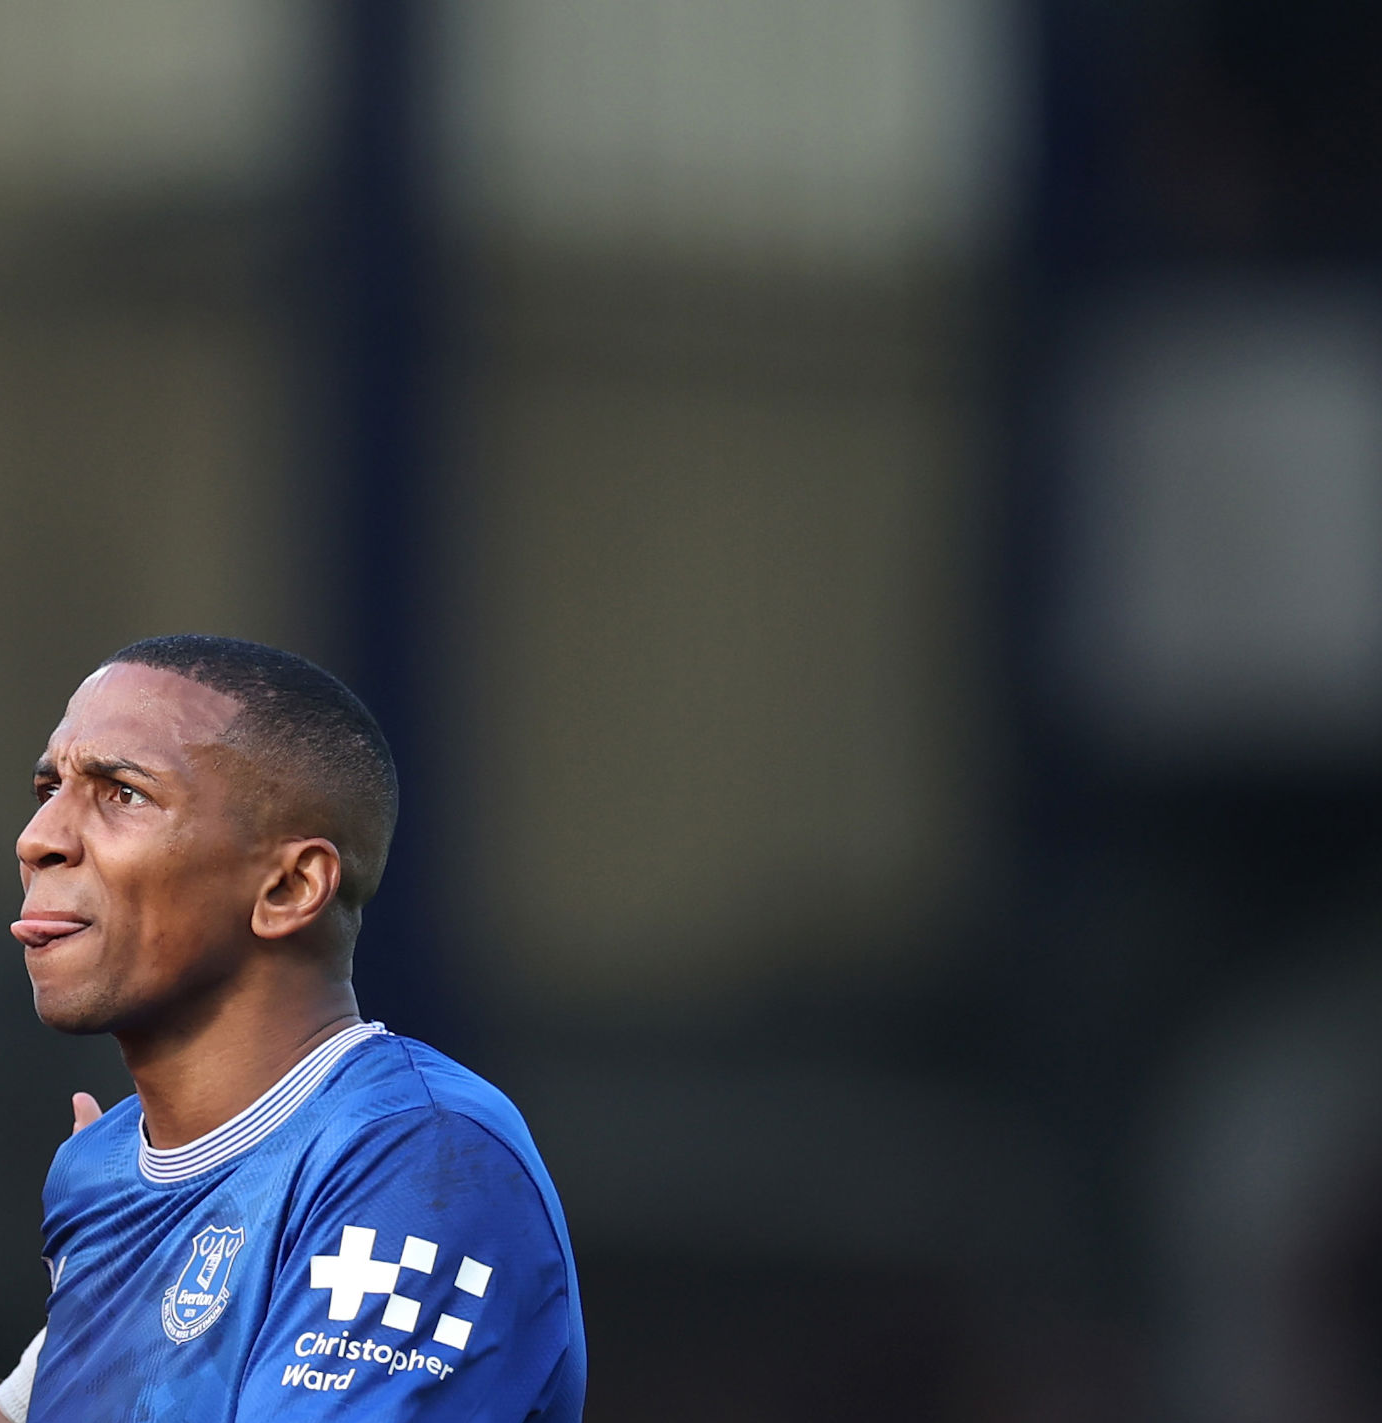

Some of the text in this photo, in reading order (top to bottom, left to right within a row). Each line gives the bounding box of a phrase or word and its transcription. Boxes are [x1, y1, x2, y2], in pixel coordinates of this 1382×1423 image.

[177, 1289, 214, 1306] Everton
[294, 1330, 454, 1381] Christopher
[281, 1363, 356, 1392] Ward
